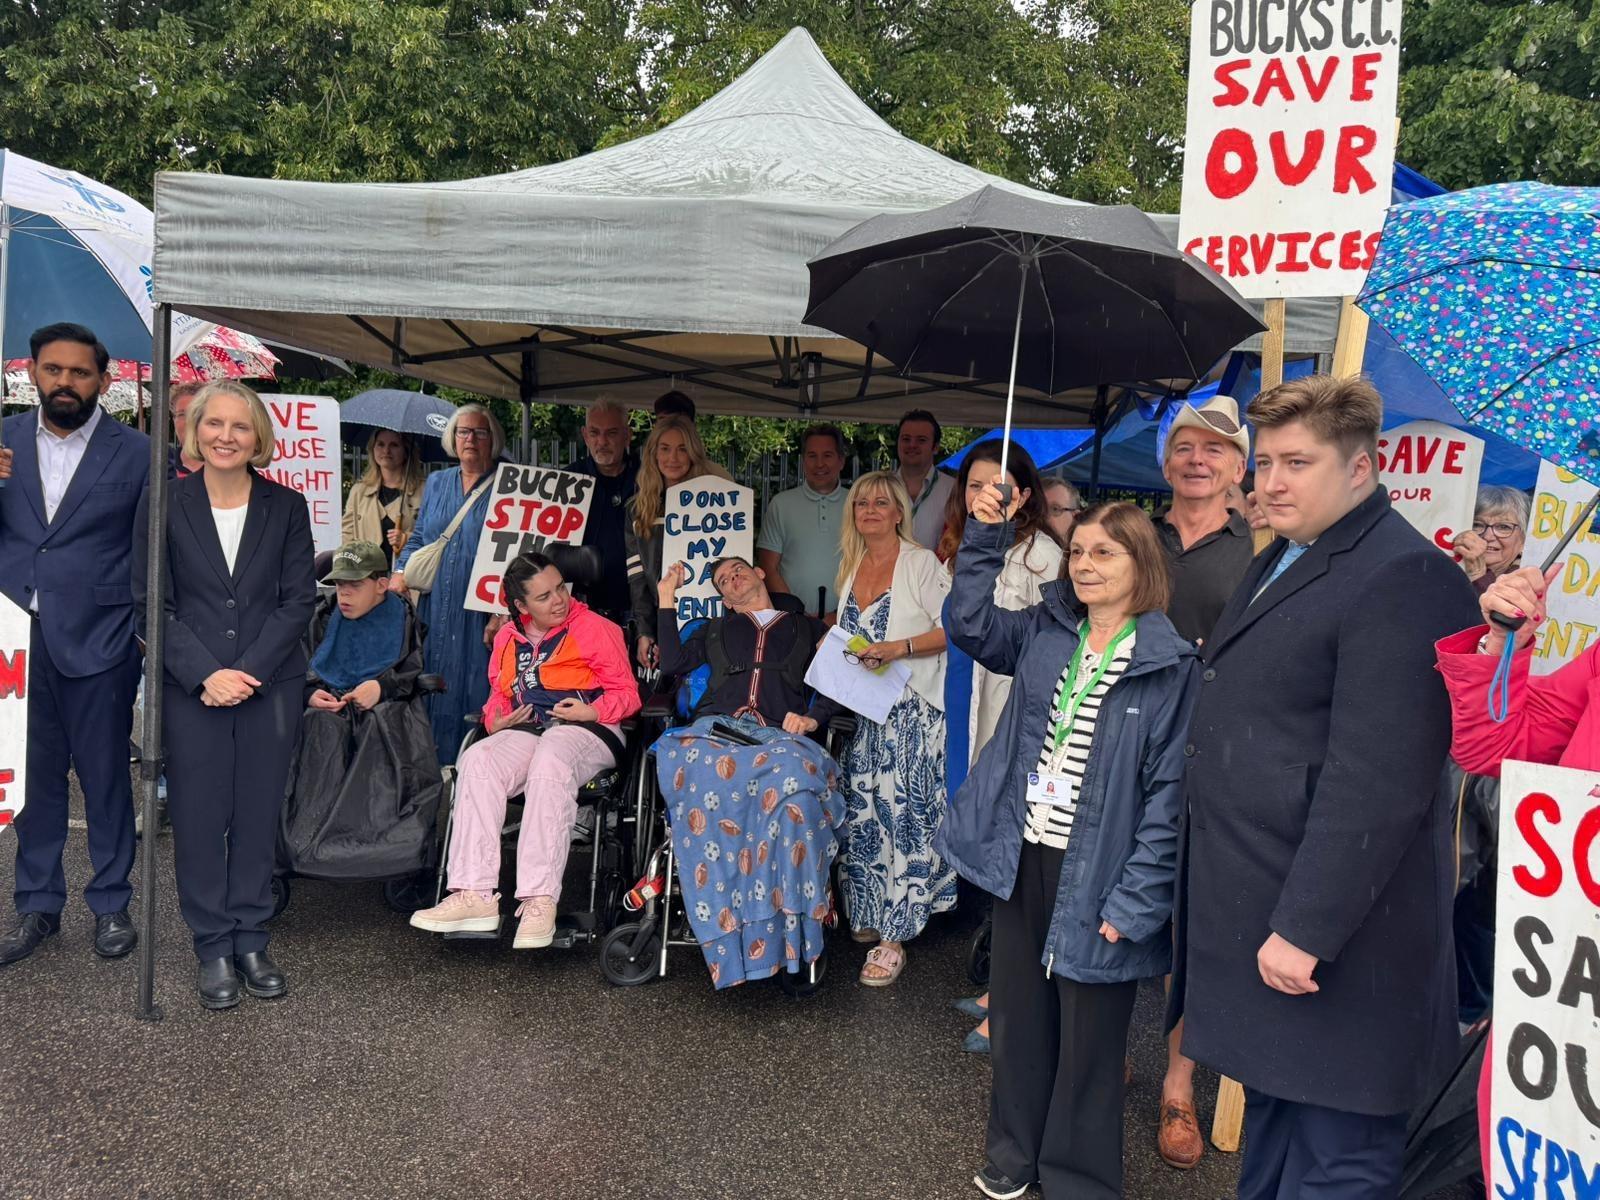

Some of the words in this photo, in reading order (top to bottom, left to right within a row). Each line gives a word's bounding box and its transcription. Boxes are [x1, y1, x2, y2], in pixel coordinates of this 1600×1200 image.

[1210, 0, 1334, 56] BUCKS
[1342, 0, 1398, 49] C.C.
[1212, 53, 1383, 107] SAVE
[1205, 125, 1378, 200] OUR
[270, 402, 318, 431] VE
[274, 436, 327, 463] OUSE
[1377, 435, 1467, 475] SAVE
[497, 465, 593, 505] BUCKS
[679, 490, 740, 508] DONT
[1390, 487, 1432, 502] OUR
[485, 497, 584, 540] STOP
[665, 512, 747, 537] CLOSE
[491, 530, 571, 562] TH
[687, 536, 727, 560] MY
[679, 560, 714, 586] DA
[673, 596, 726, 620] ENT
